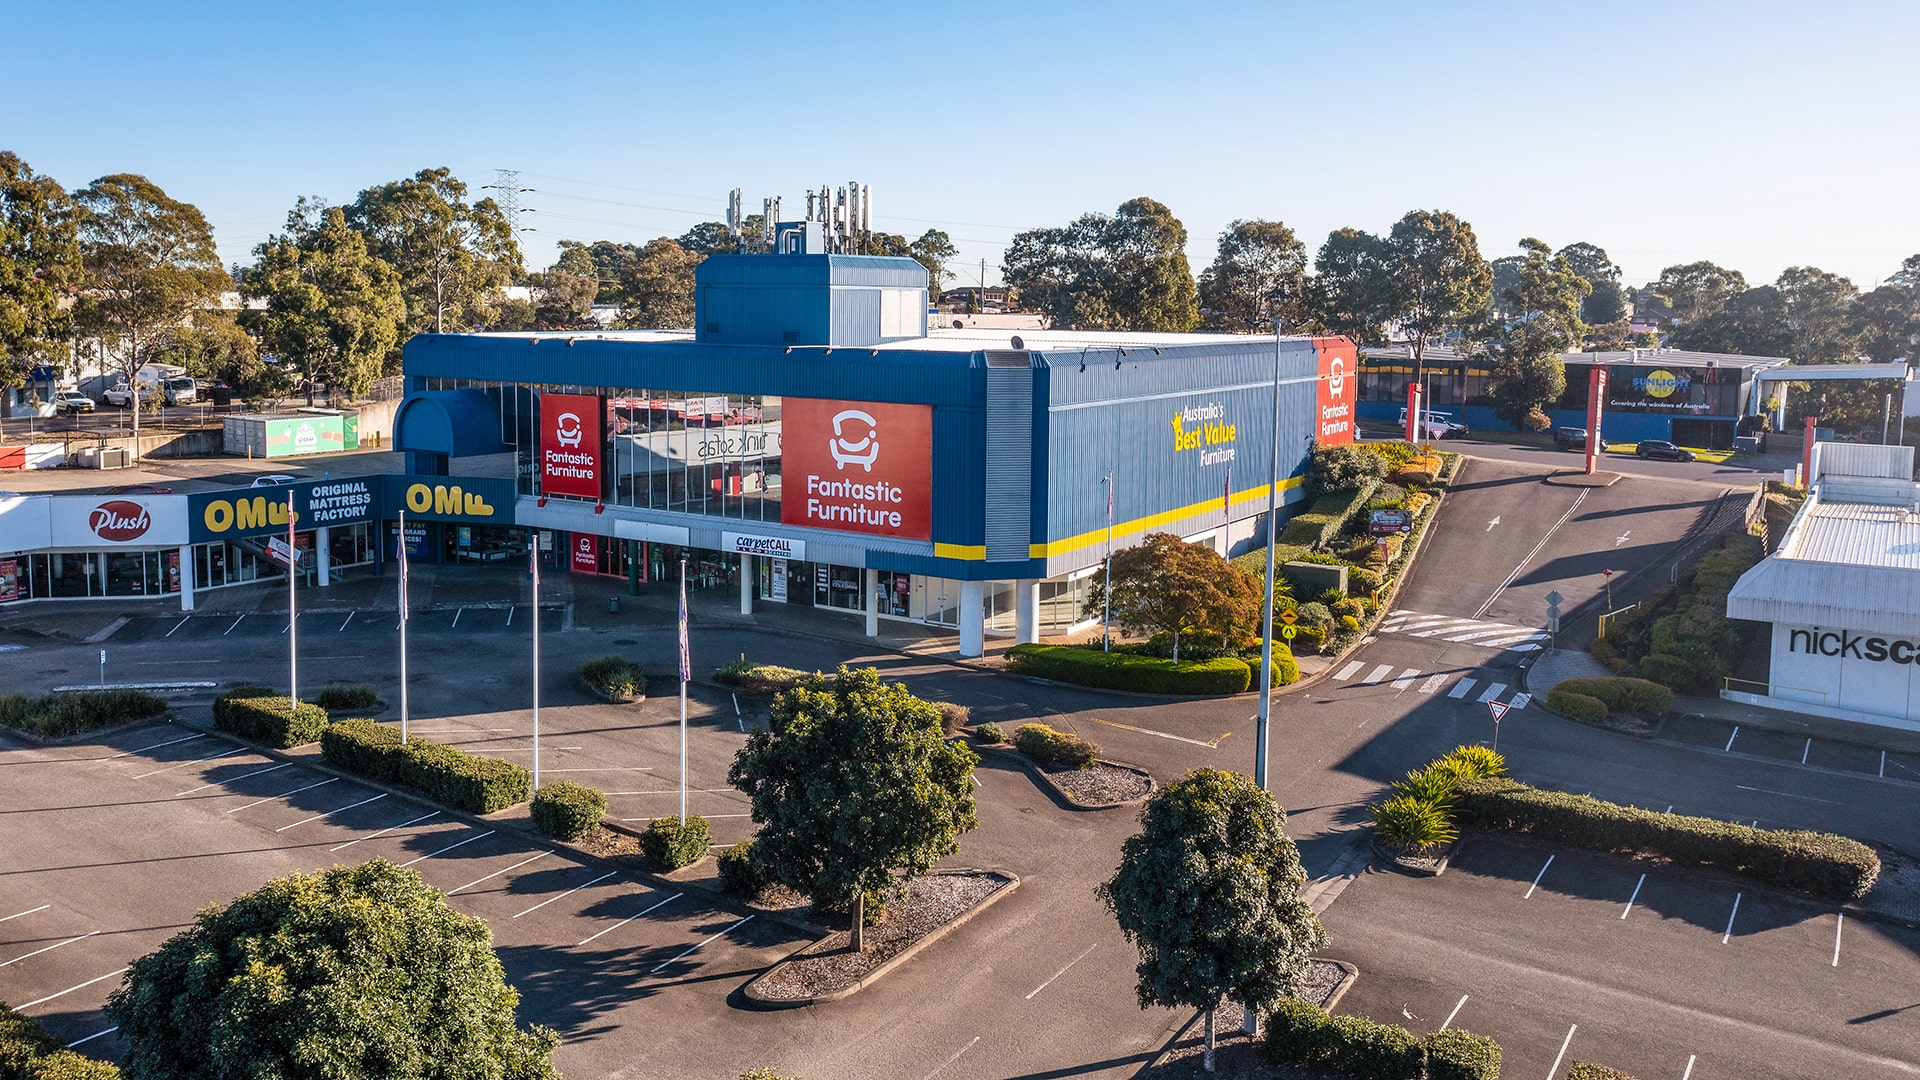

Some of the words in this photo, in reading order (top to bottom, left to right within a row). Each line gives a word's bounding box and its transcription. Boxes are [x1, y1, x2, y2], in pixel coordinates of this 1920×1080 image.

[1632, 377, 1691, 387] SUNLIGHT
[1182, 401, 1224, 422] Australia's
[1322, 402, 1349, 420] Fantastic
[1610, 399, 1636, 408] Covering
[1675, 401, 1683, 409] of
[1683, 402, 1710, 410] Australia
[1175, 424, 1202, 452] Best
[1204, 419, 1236, 446] Value
[1321, 419, 1349, 436] Furniture
[545, 450, 594, 466] Fantastic
[1200, 447, 1235, 467] Furniture
[546, 463, 594, 480] Furniture
[312, 481, 368, 498] ORIGINAL
[807, 475, 903, 503] Fantastic
[309, 493, 371, 510] MATTRESS
[92, 507, 149, 536] Plush
[313, 505, 368, 522] FACTORY
[807, 498, 903, 528] Furniture
[736, 536, 792, 552] carpetCALL
[1789, 626, 1920, 666] nicksc
